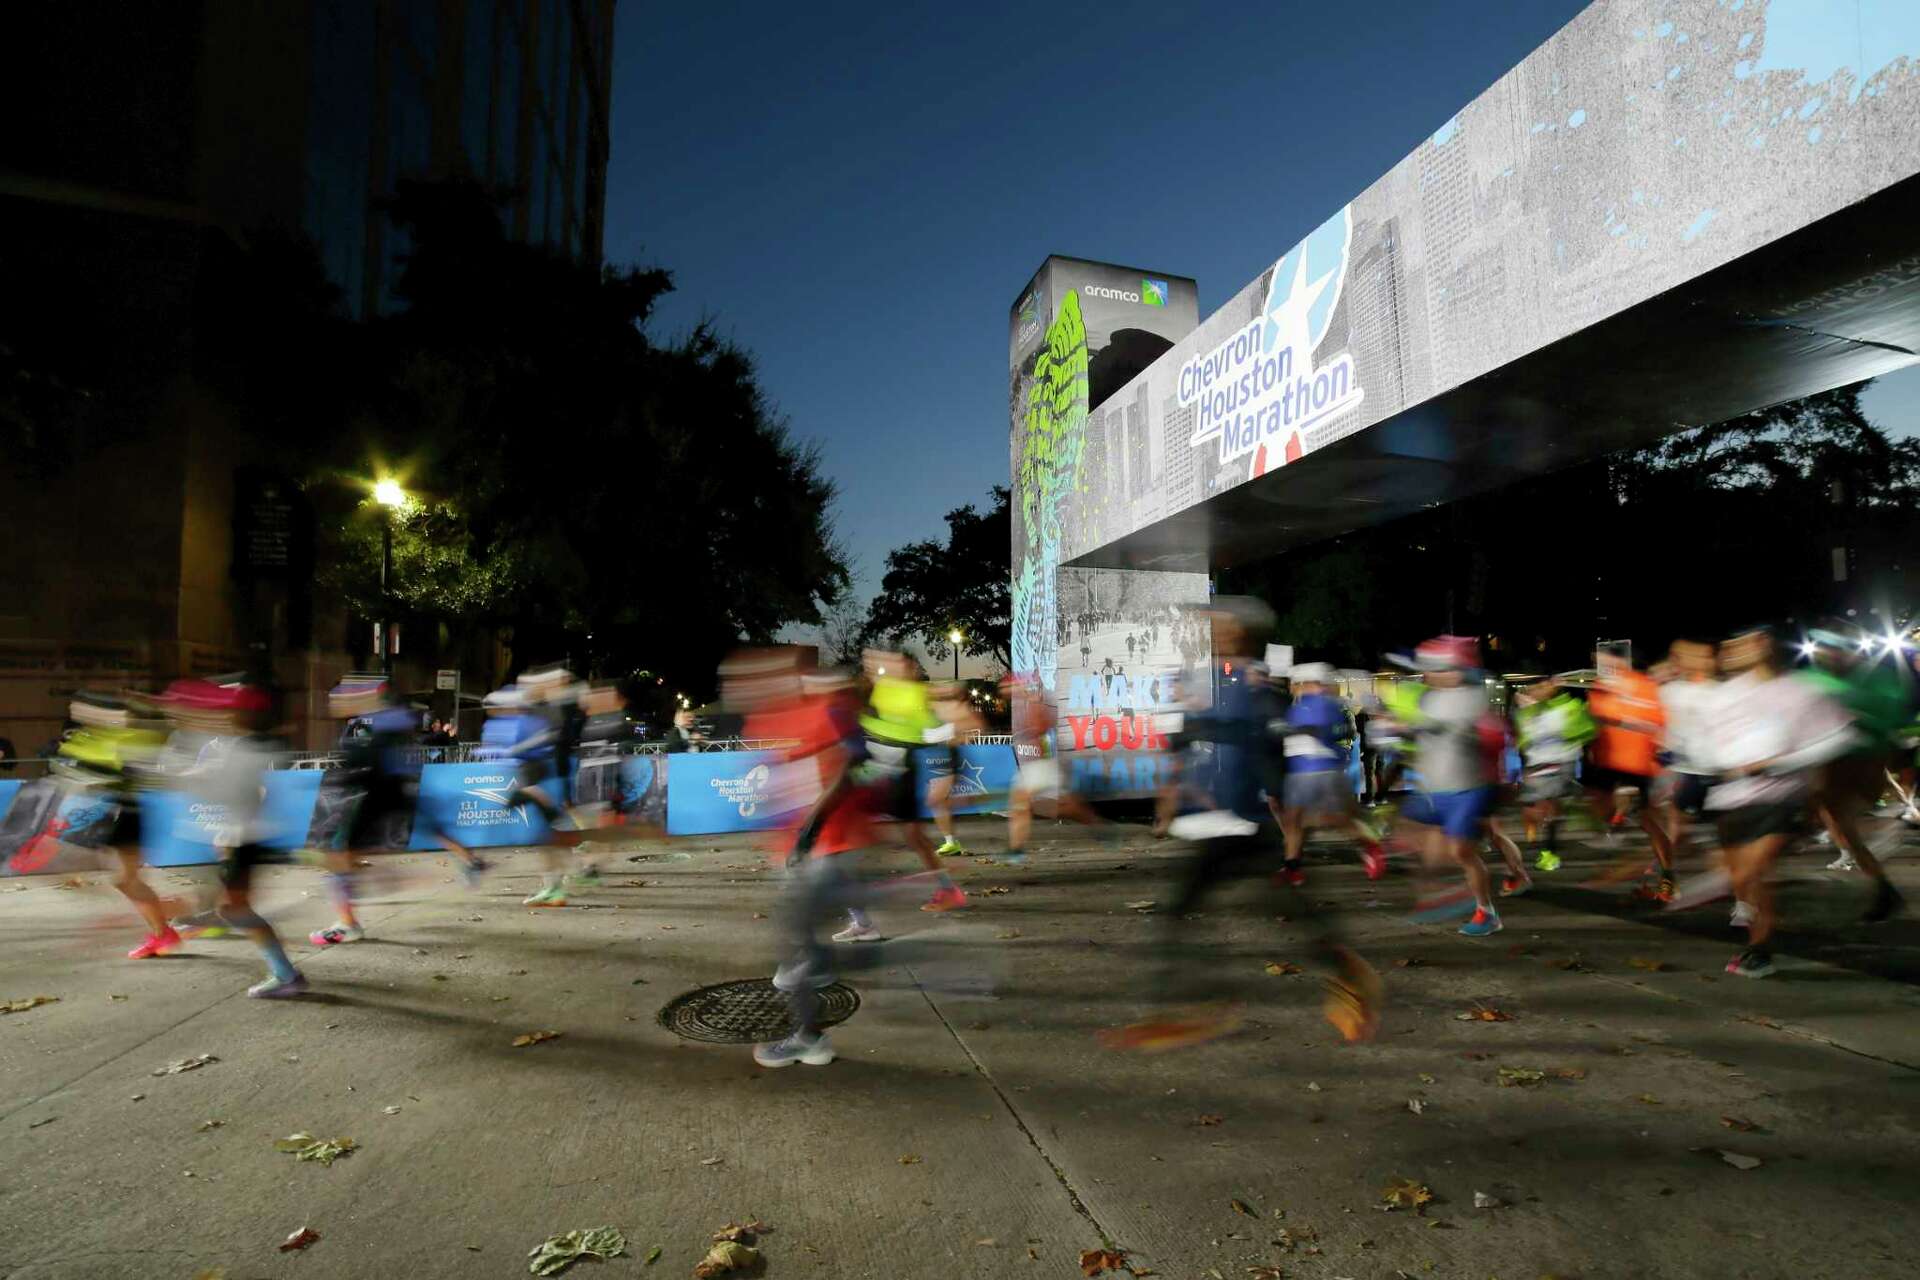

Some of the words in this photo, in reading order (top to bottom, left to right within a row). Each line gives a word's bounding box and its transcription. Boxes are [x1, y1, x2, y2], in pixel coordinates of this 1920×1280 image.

[1084, 284, 1140, 303] aramco
[1180, 323, 1261, 402] Chevron
[1200, 345, 1293, 431] Houston
[1222, 361, 1348, 457] Marathon
[464, 776, 505, 784] aramco
[711, 778, 744, 787] Chevron
[458, 808, 511, 821] HOUSTON
